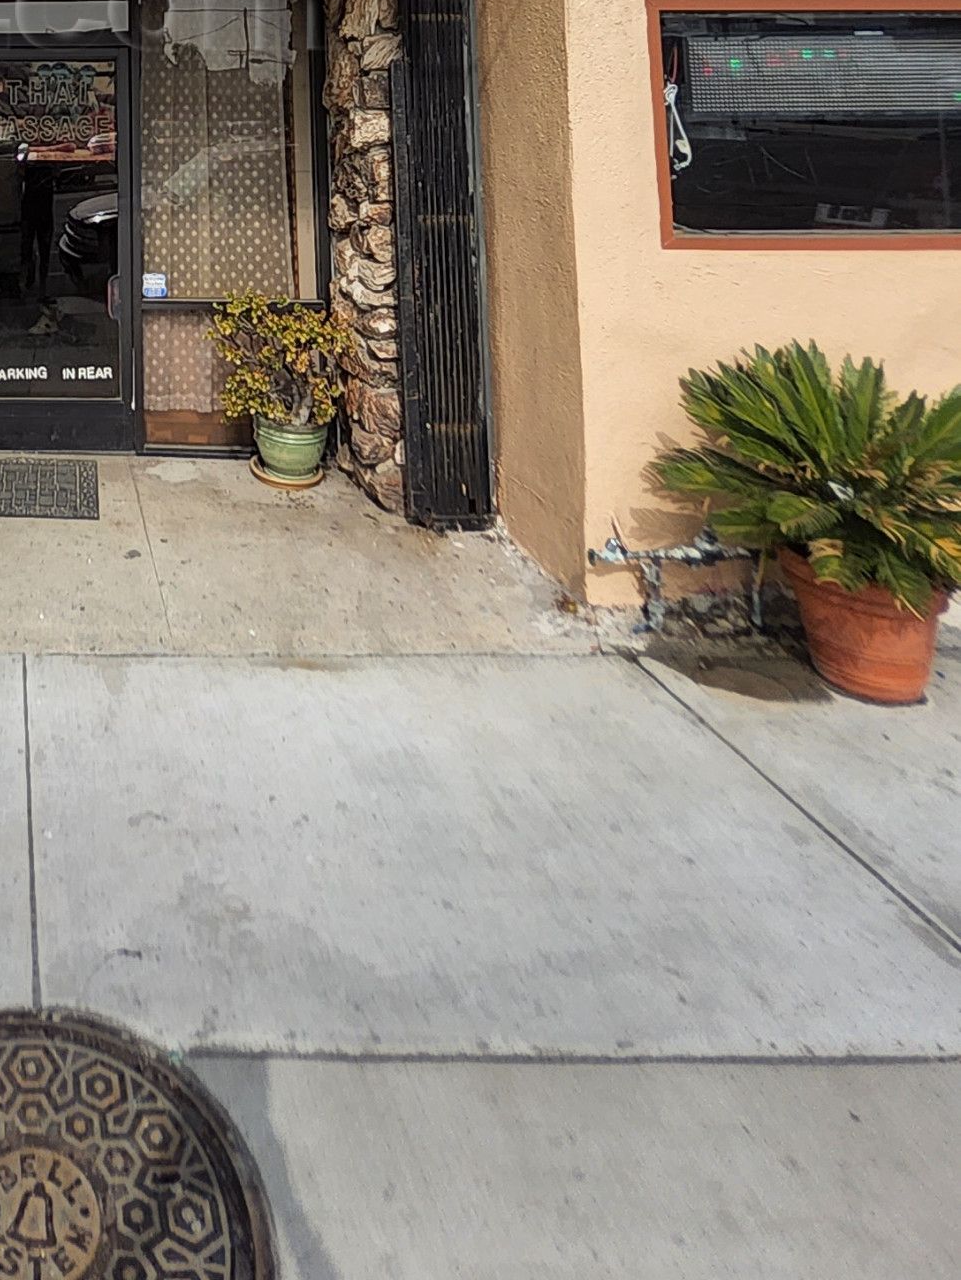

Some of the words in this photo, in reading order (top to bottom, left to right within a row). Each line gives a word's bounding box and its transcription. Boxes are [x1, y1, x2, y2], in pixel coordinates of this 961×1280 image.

[5, 79, 90, 105] THAI
[62, 367, 76, 380] IN
[78, 366, 113, 380] REAR
